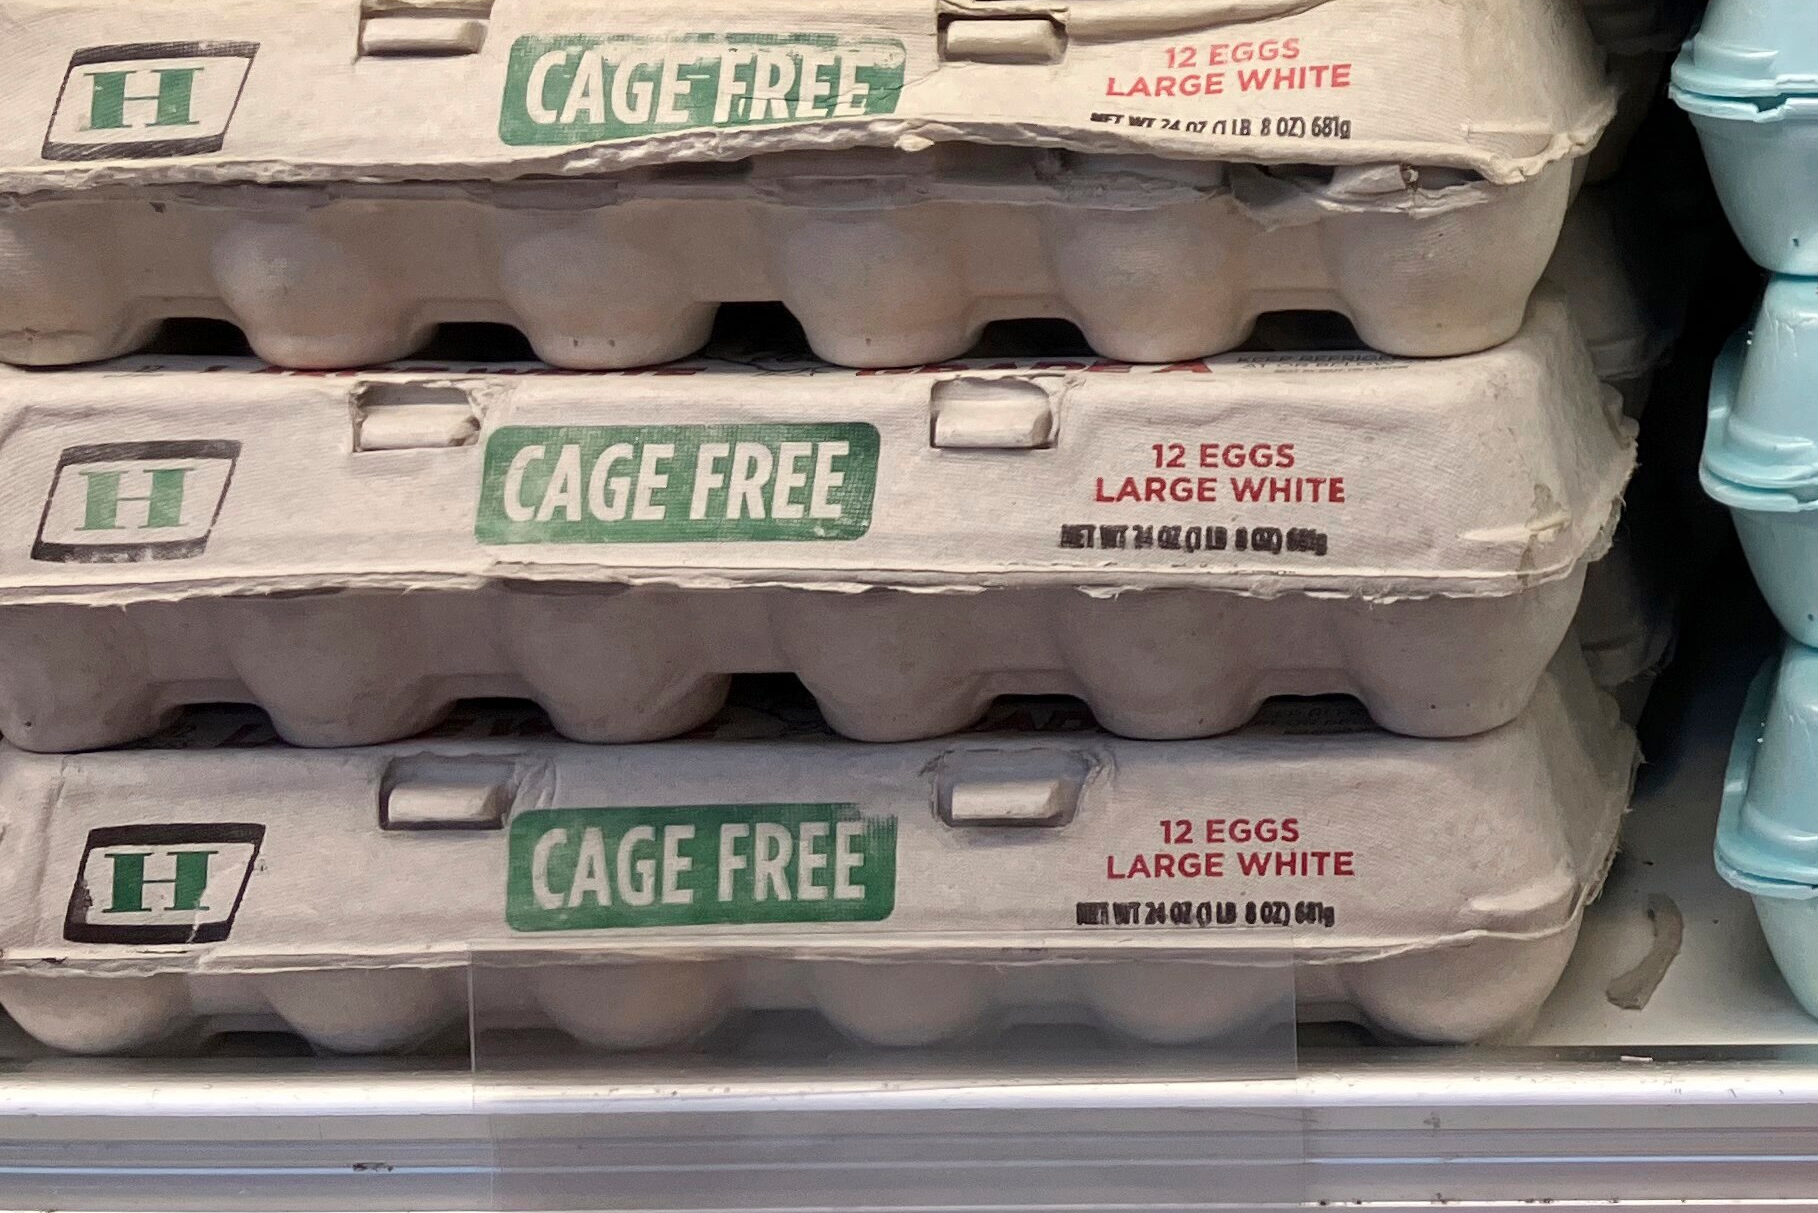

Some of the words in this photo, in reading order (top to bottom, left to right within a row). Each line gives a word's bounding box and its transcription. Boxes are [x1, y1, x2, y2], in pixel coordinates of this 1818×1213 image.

[1165, 45, 1196, 69] 12
[1208, 38, 1300, 66] EGGS
[525, 50, 694, 125] CAGE
[712, 50, 871, 125] FREE
[1105, 72, 1224, 98] LARGE
[1237, 63, 1352, 91] WHITE
[83, 67, 206, 130] H
[1311, 115, 1351, 140] 681g
[1152, 443, 1186, 468] 12
[1200, 443, 1295, 468] EGGS
[76, 466, 195, 532] H
[504, 444, 669, 522] CAGE
[688, 441, 850, 521] FREE
[1095, 476, 1217, 503] LARGE
[1230, 476, 1346, 503] WHITE
[1159, 819, 1193, 844] 12
[1206, 818, 1300, 843] EGGS
[101, 849, 220, 914] H
[531, 824, 694, 909] CAGE
[717, 820, 866, 903] FREE
[1106, 853, 1224, 879] LARGE
[1237, 851, 1355, 877] WHITE
